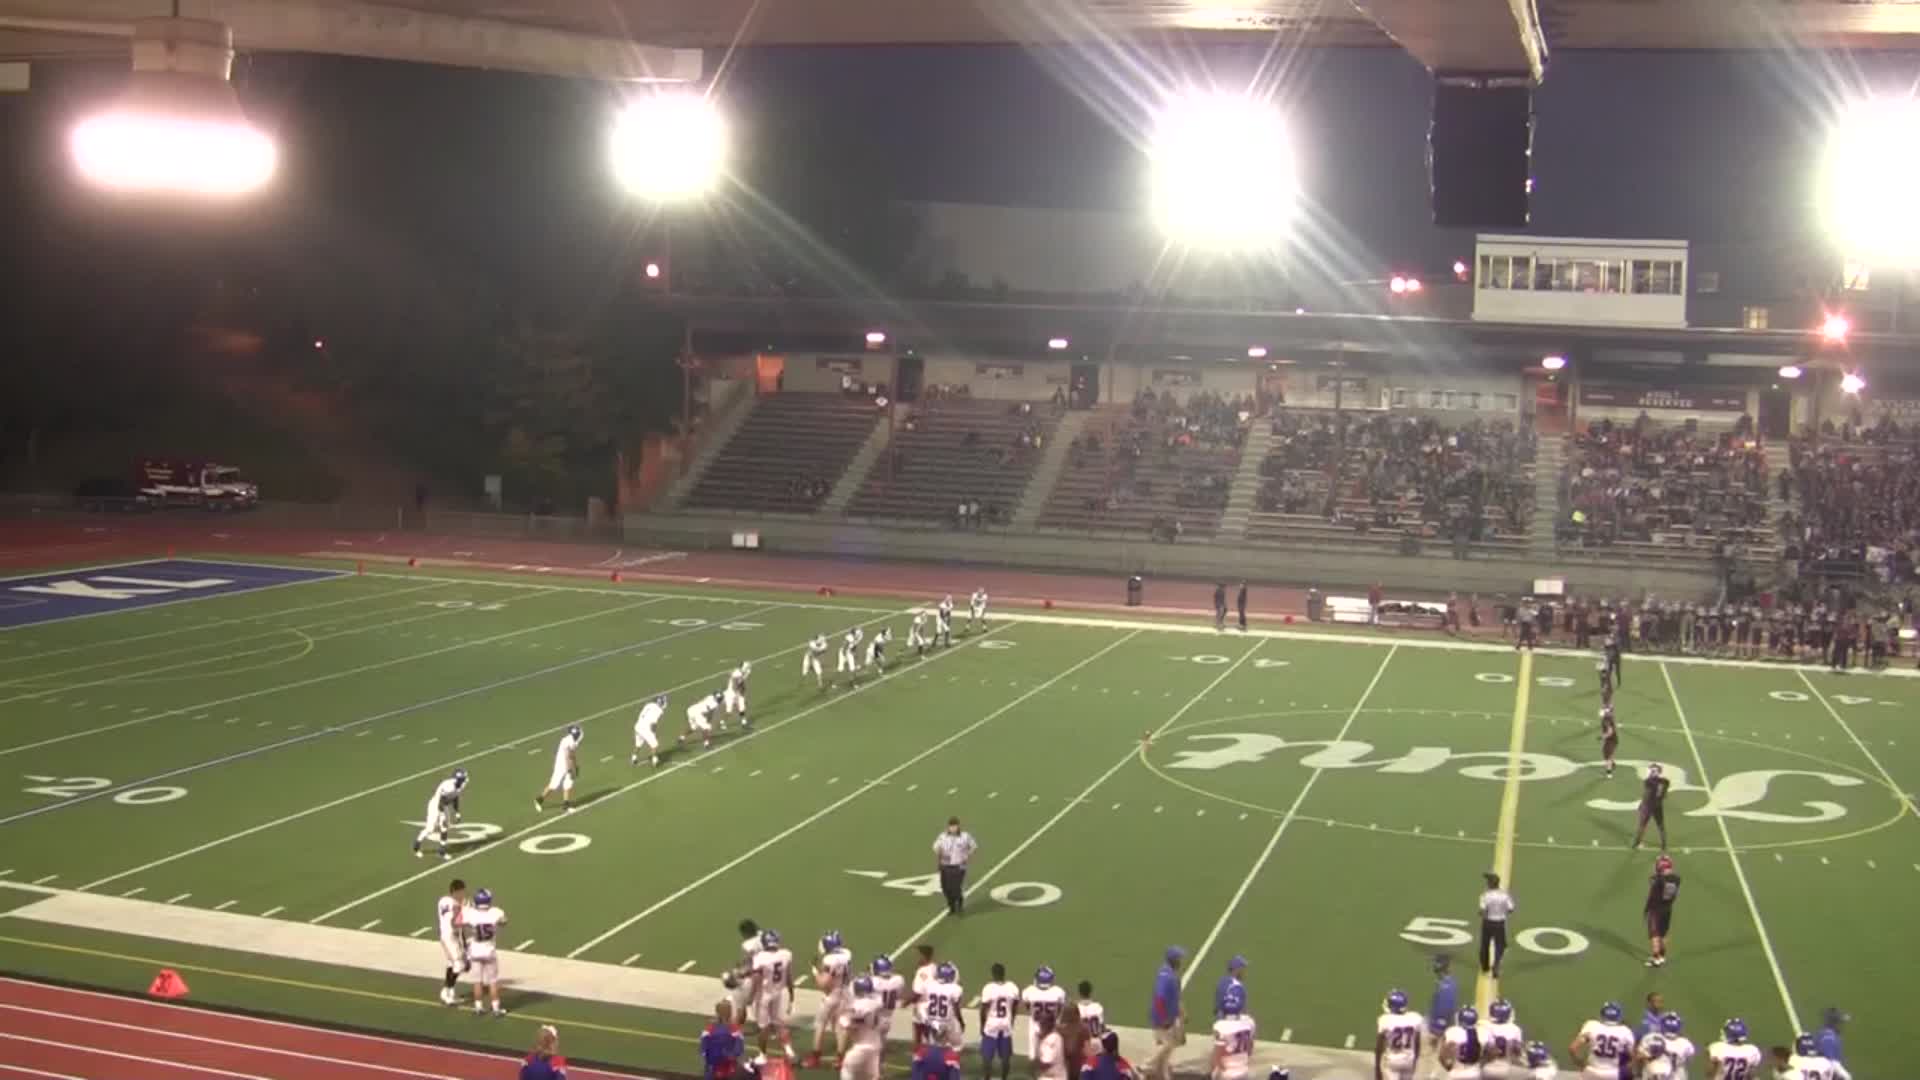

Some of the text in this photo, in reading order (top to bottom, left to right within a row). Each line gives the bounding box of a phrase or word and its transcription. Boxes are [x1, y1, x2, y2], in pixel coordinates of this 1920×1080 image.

[1400, 916, 1590, 955] 50
[928, 993, 949, 1018] 26
[1594, 1034, 1620, 1059] 35
